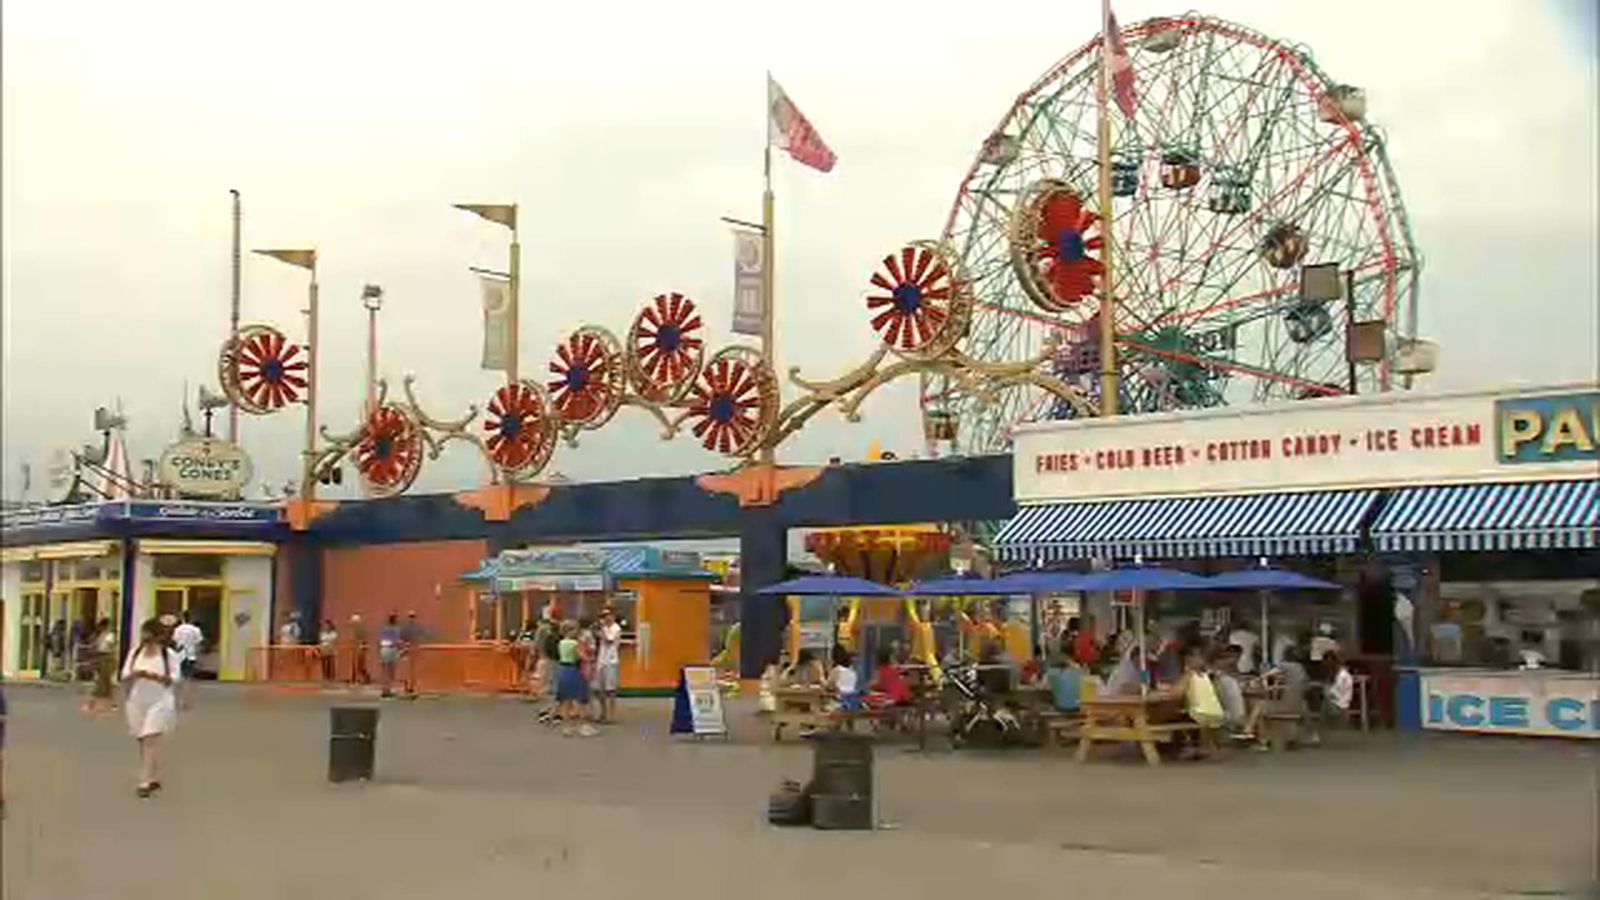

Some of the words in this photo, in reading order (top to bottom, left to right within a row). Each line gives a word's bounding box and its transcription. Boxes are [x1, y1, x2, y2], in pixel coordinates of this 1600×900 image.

[1036, 454, 1079, 474] FRIES
[1097, 450, 1134, 470] COLD
[1142, 446, 1184, 467] BEER
[1206, 439, 1271, 461] COTTON
[1282, 434, 1342, 457] CANDY
[1366, 429, 1398, 451] ICE
[1411, 424, 1481, 449] CREAM
[1501, 408, 1600, 457] PA
[179, 467, 231, 481] CONES
[1429, 694, 1529, 726] ICE
